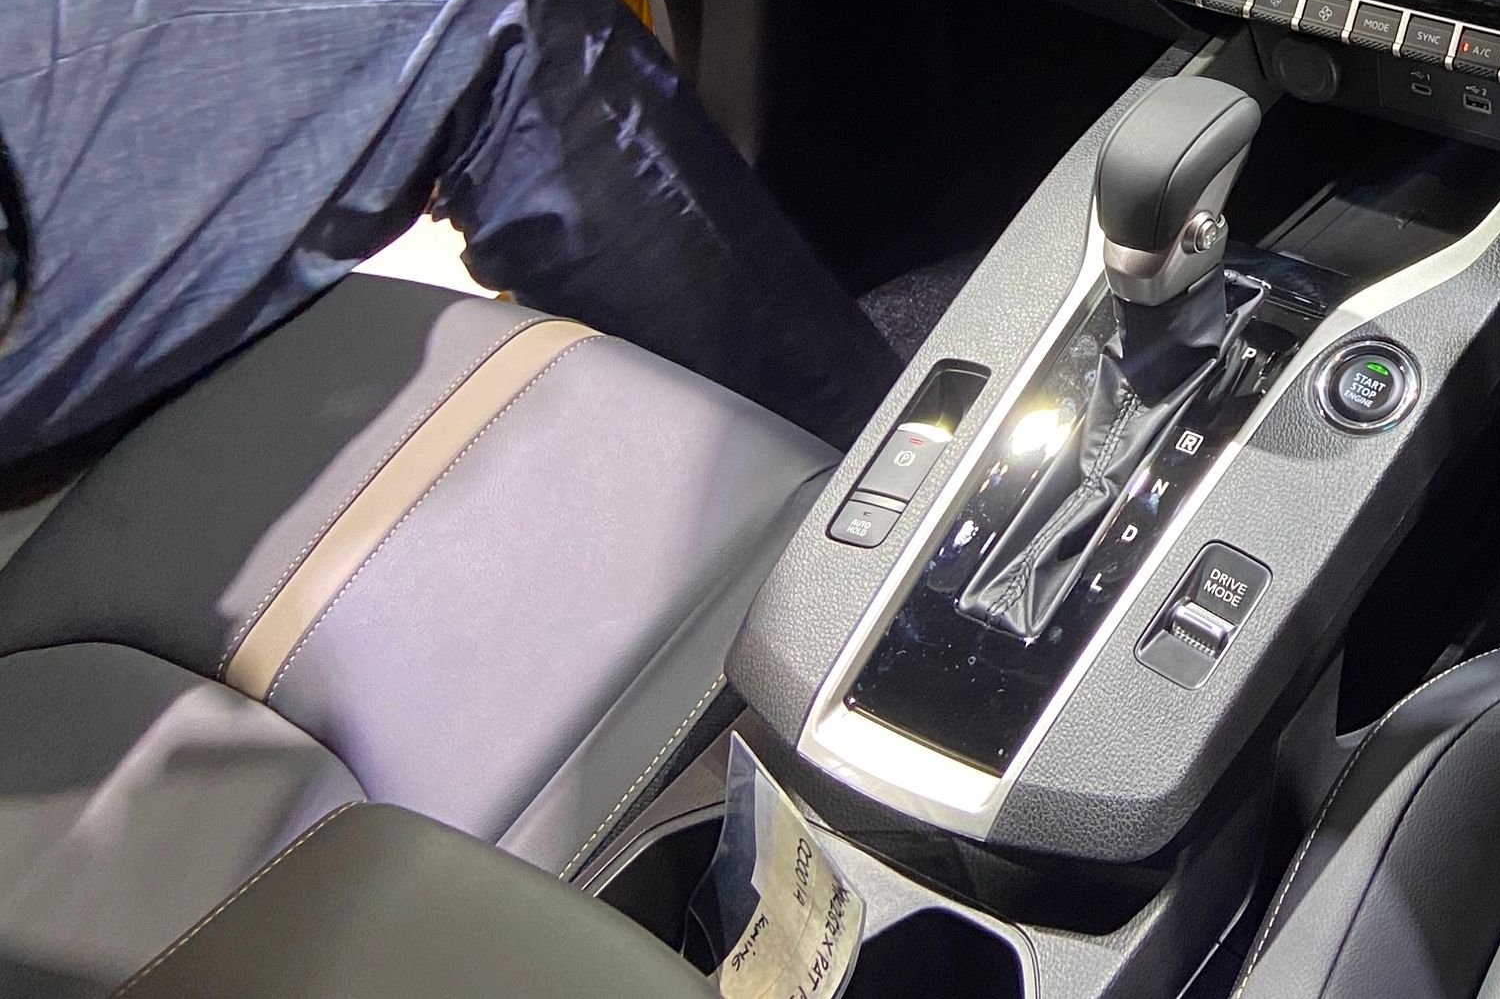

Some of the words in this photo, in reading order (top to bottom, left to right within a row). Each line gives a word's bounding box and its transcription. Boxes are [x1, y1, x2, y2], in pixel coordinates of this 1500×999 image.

[1363, 18, 1390, 33] MODE
[1416, 31, 1441, 45] SYNC
[1472, 46, 1491, 58] A/C
[1241, 347, 1257, 360] P
[1350, 382, 1377, 399] STOP
[1353, 372, 1386, 392] START
[1343, 390, 1373, 408] ENGINE
[1182, 434, 1196, 450] R
[1152, 479, 1169, 496] N
[847, 525, 867, 537] HOLD
[850, 518, 871, 529] AUTO
[1121, 525, 1138, 542] D
[1090, 573, 1103, 591] L
[1210, 568, 1248, 595] DRIVE
[1203, 580, 1242, 607] MODE
